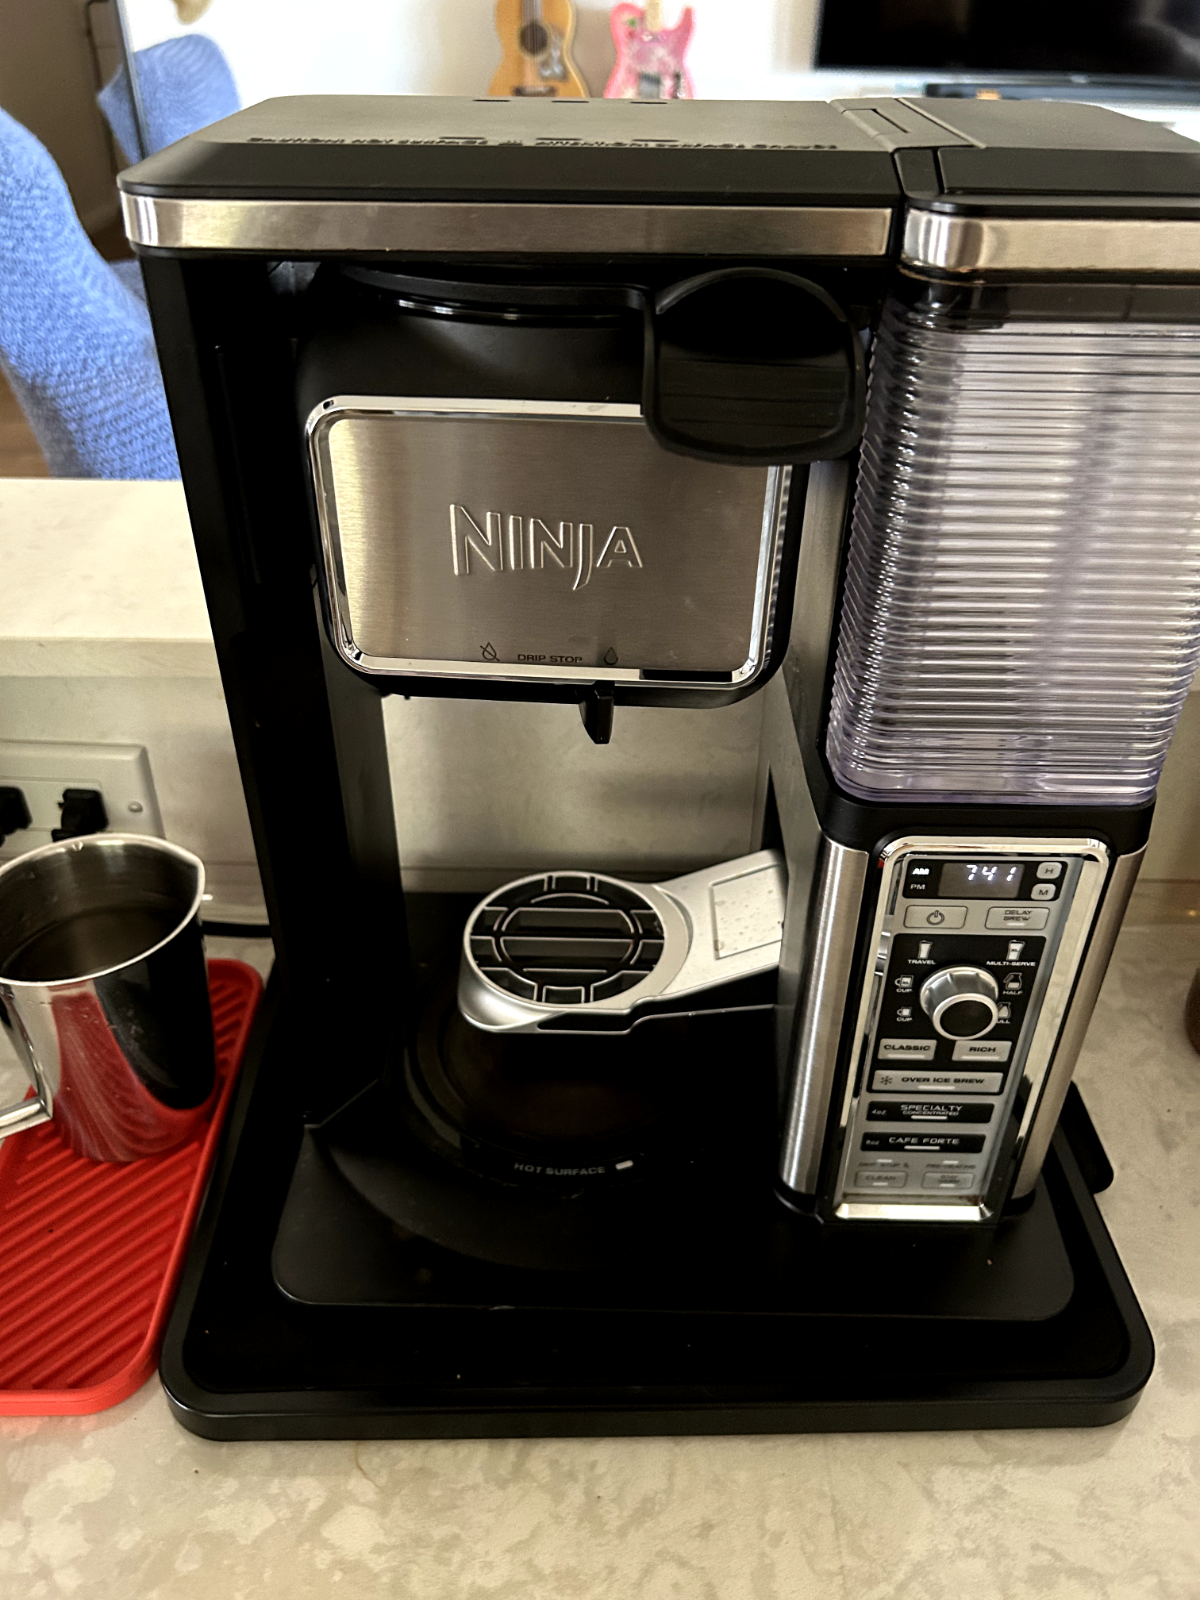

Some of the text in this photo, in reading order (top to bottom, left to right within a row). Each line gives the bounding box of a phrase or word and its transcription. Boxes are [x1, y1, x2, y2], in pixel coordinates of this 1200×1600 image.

[450, 504, 643, 590] NINJA
[517, 653, 583, 663] DRIP STOP
[911, 867, 930, 876] AM
[883, 1044, 931, 1052] CLASSIC
[900, 1104, 963, 1112] SPECIALTY
[888, 1136, 960, 1145] CAFE FORTE
[513, 1162, 606, 1176] HOT SURFACE
